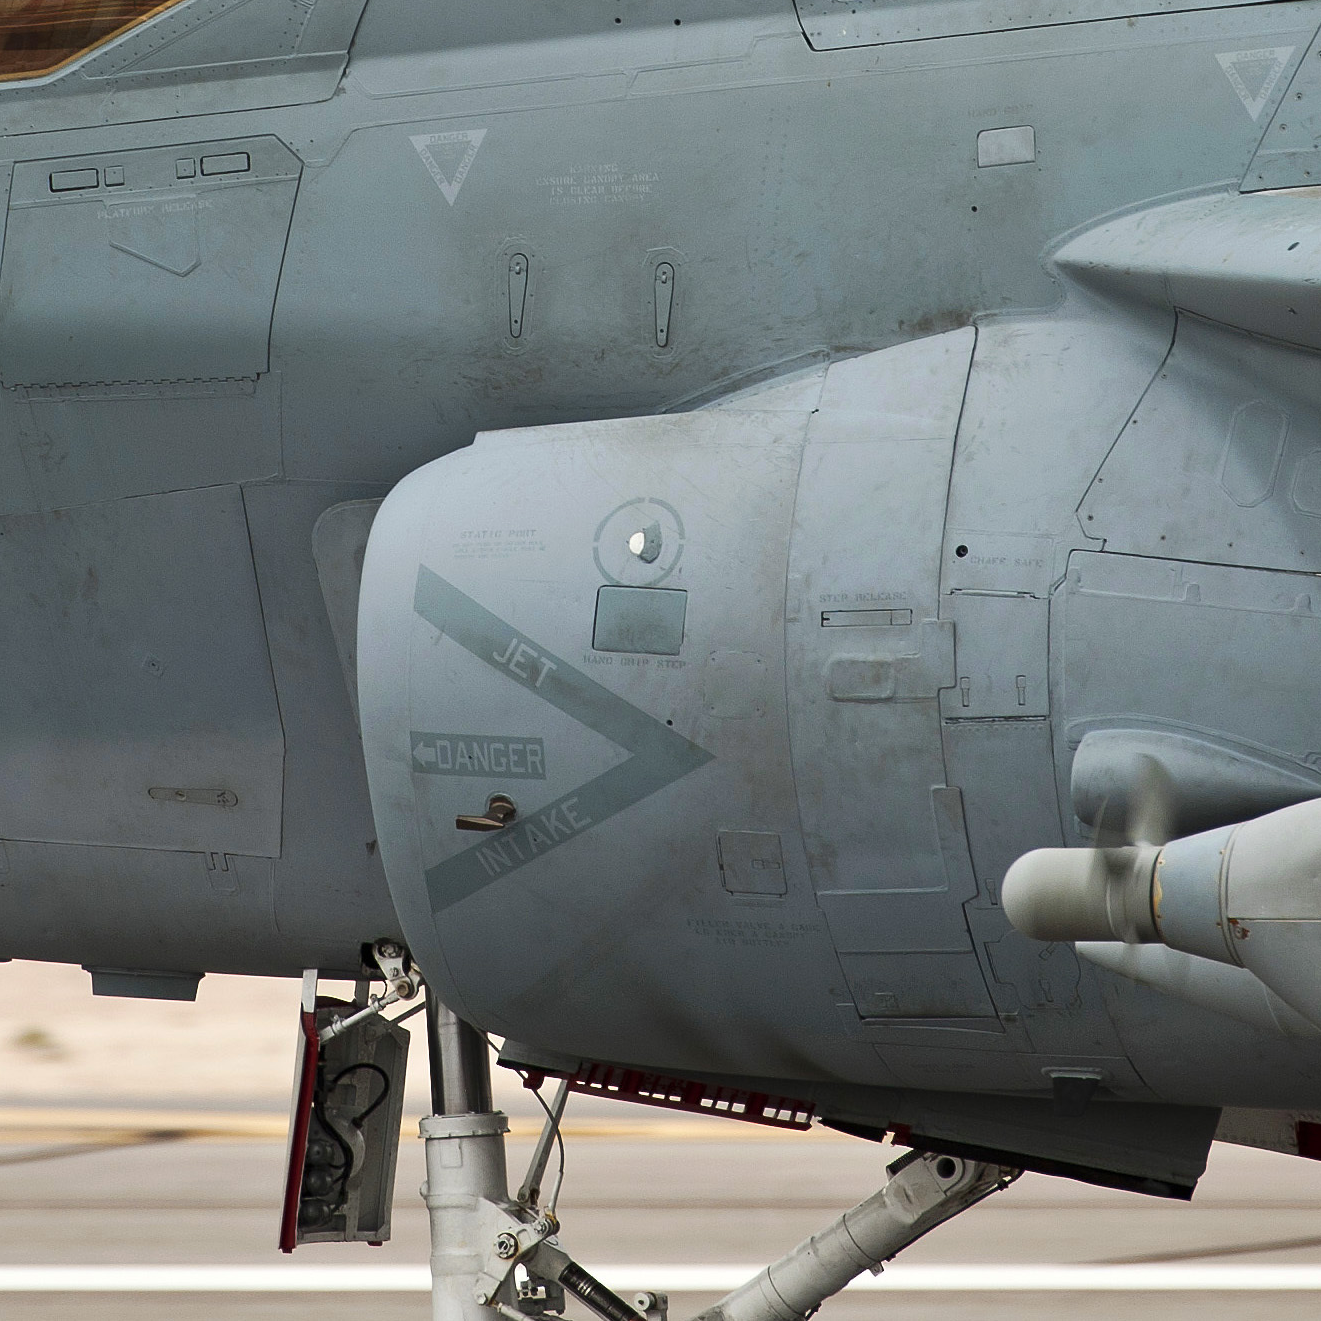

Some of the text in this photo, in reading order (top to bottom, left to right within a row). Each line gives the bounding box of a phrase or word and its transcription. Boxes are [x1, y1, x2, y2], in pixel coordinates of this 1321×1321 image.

[1238, 49, 1276, 59] DANGER
[429, 132, 468, 143] DANGER
[420, 148, 446, 185] DANGER
[454, 144, 478, 184] DANGER
[461, 529, 537, 538] STATIC PORT
[819, 591, 907, 603] STEP RELEASE
[492, 638, 558, 687] JET
[583, 655, 686, 669] HAND GRIP STEP
[436, 739, 544, 774] DANGER
[475, 796, 592, 876] INTAKE
